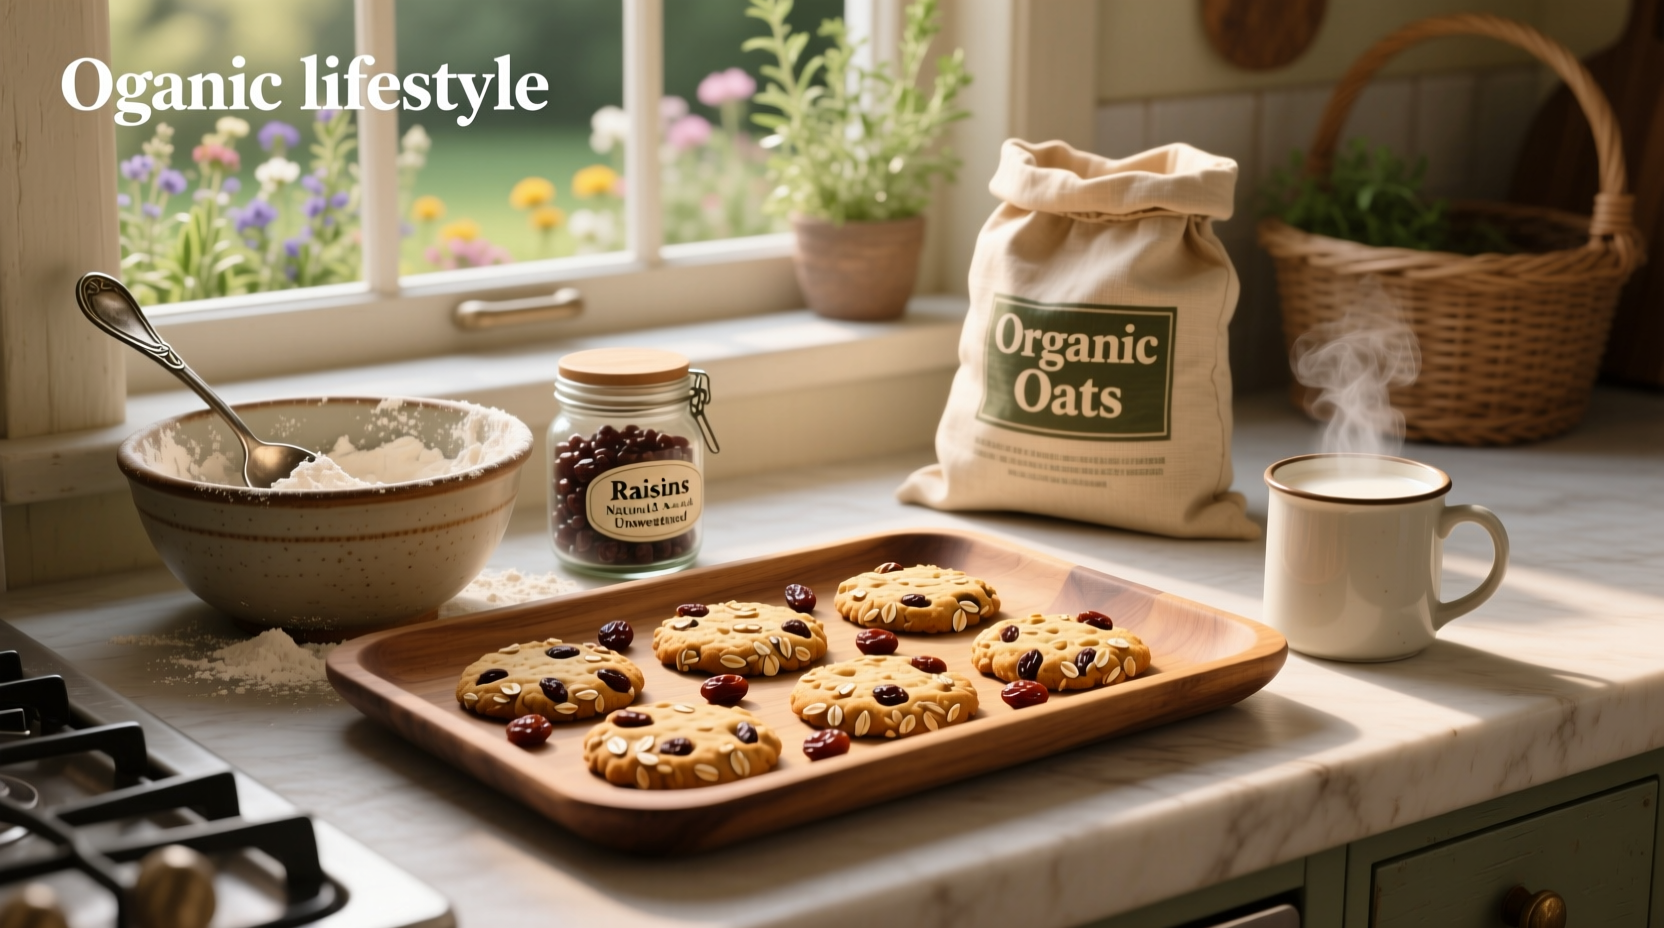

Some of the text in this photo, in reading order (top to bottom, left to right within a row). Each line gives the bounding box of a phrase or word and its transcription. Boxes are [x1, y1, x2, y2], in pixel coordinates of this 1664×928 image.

[995, 313, 1158, 372] Organic
[1014, 368, 1122, 419] Oats
[610, 477, 690, 501] Raisins
